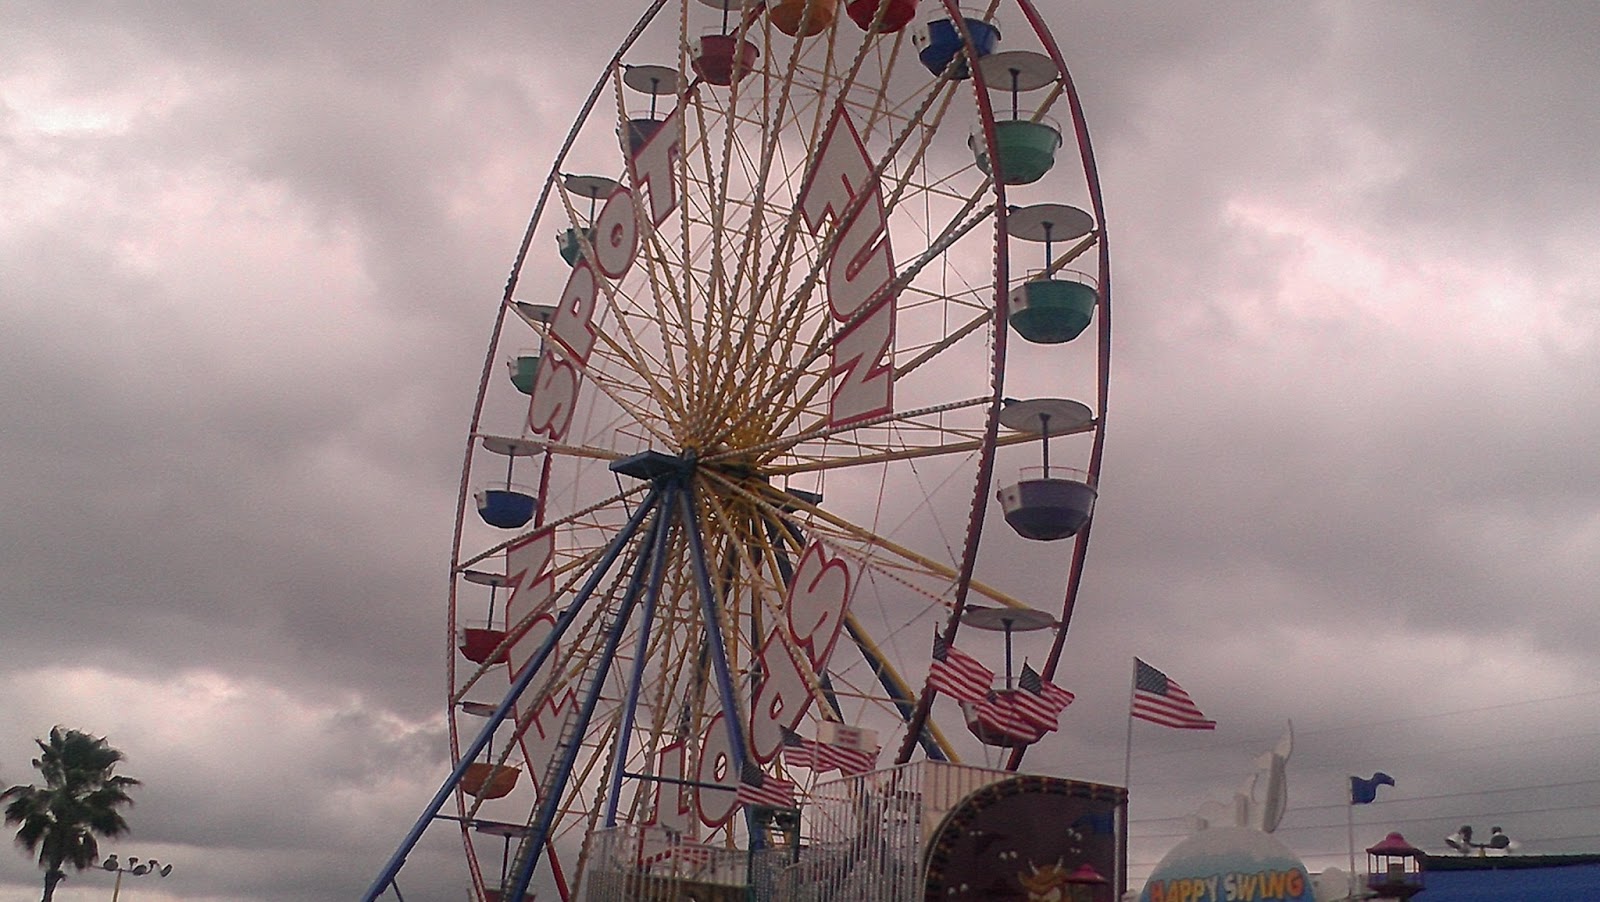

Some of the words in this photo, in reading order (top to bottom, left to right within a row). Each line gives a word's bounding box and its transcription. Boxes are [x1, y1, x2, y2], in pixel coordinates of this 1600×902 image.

[529, 104, 683, 441] SPOT
[799, 104, 896, 428] FUN
[638, 540, 850, 858] SPOT
[1150, 873, 1221, 902] HAPPY
[1223, 868, 1304, 901] SWING
